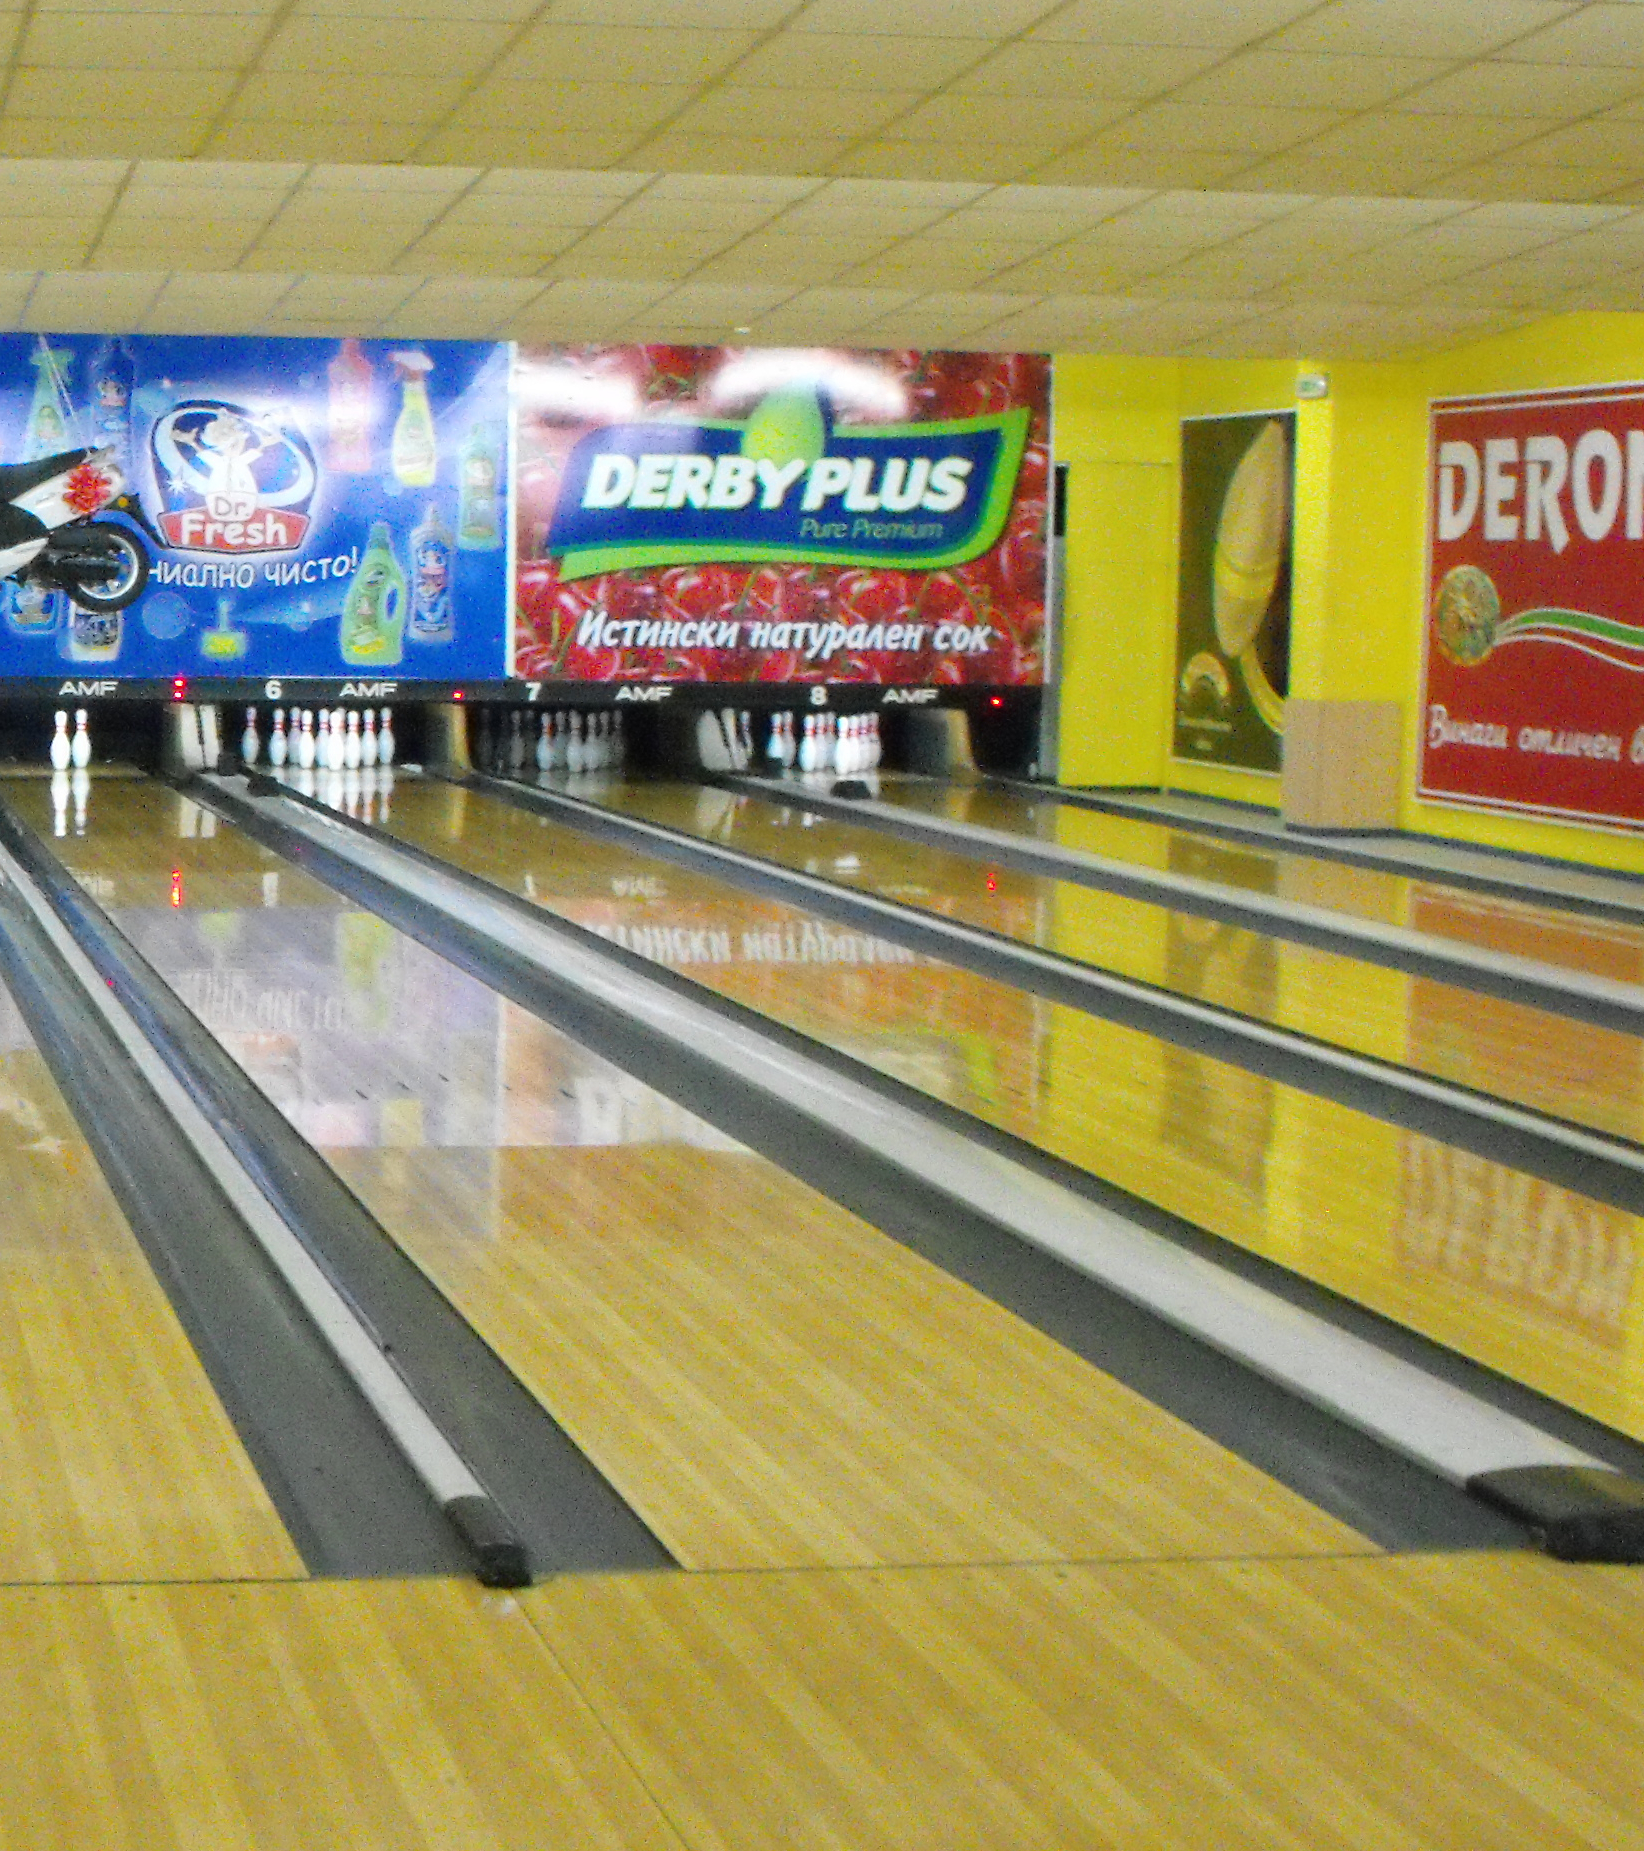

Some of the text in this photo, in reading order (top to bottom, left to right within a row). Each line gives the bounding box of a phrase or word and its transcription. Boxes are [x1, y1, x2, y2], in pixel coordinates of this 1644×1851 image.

[582, 453, 973, 512] DERBY PLUS
[214, 496, 250, 517] Dr.
[181, 513, 287, 545] Fresh
[800, 518, 944, 539] Pure Premium
[577, 609, 993, 660] Истински натурален сок
[58, 681, 119, 696] AMF
[265, 681, 282, 699] 6
[338, 682, 398, 697] AMF
[524, 683, 541, 702] 7
[614, 686, 673, 701] AMF
[810, 686, 828, 705] 8
[881, 688, 939, 704] AMF
